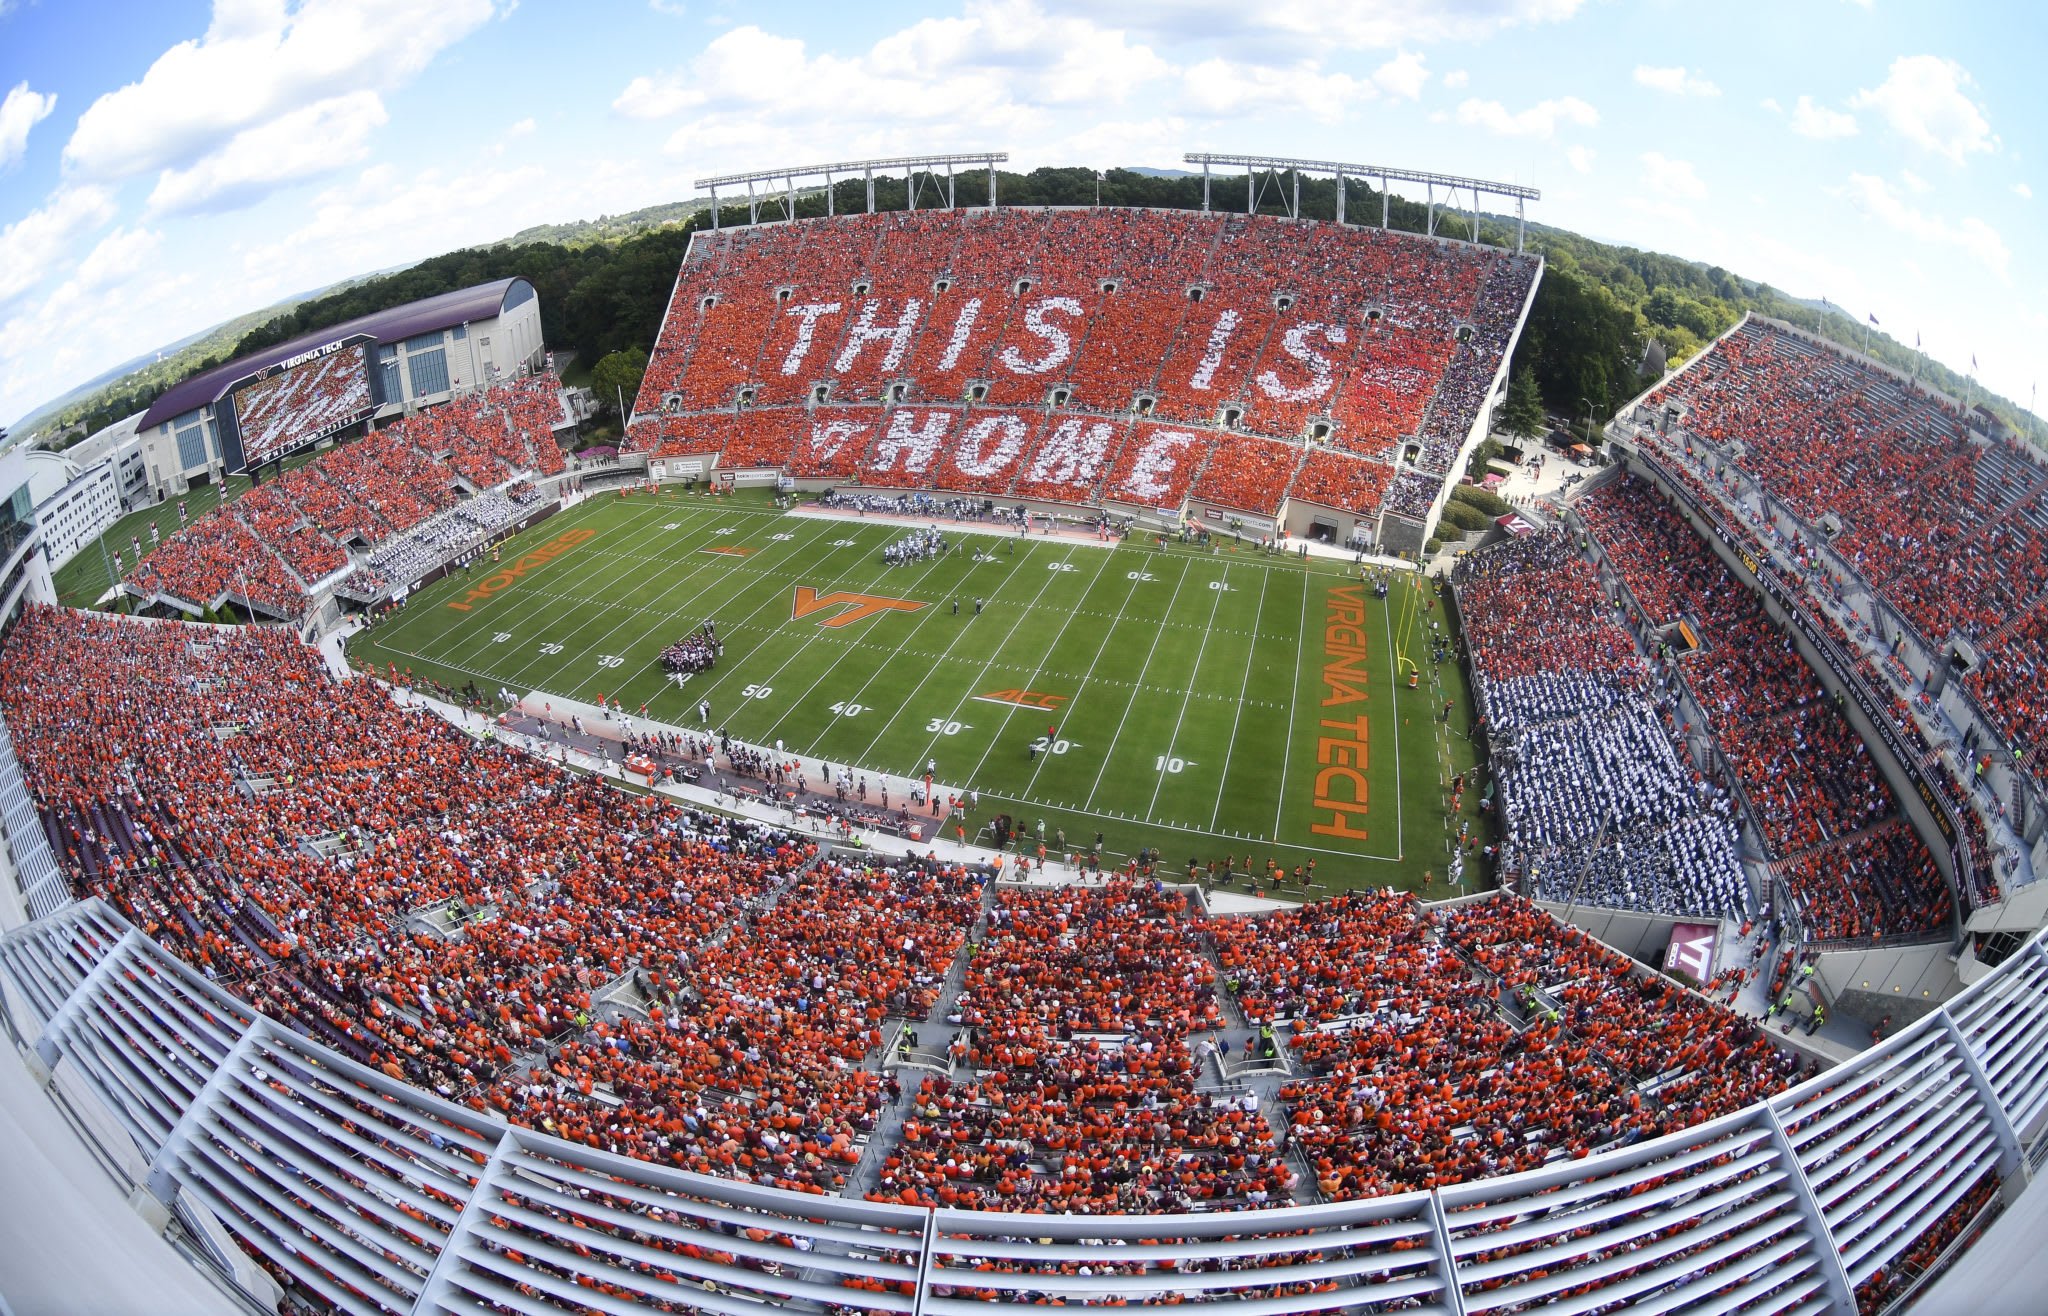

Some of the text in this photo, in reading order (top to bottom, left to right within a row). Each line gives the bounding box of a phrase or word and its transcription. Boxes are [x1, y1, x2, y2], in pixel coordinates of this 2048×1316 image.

[280, 340, 343, 371] VIRGINIA TECH
[781, 297, 1348, 403] THIS IS
[255, 365, 272, 381] VT
[865, 410, 1196, 501] HOME
[454, 541, 490, 566] HOKIES
[447, 528, 597, 611] HOKIES
[1047, 562, 1075, 572] 30
[1742, 554, 1758, 575] 15:00
[1127, 571, 1154, 582] 20
[790, 585, 934, 629] VT
[493, 632, 512, 643] 10
[538, 643, 564, 655] 20
[597, 656, 625, 668] 30
[741, 684, 773, 699] 50
[979, 688, 1069, 710] ACC
[828, 701, 863, 717] 40
[1311, 585, 1369, 841] VIRGINIA TECH
[1804, 626, 1816, 642] NEED
[1815, 639, 1822, 649] TO
[1821, 647, 1833, 665] COOL
[1862, 700, 1873, 715] GOT
[1872, 714, 1881, 728] ICE
[1880, 724, 1893, 745] COLD
[1892, 742, 1910, 770] DRINKS
[1909, 769, 1917, 780] AT
[925, 717, 962, 736] 30
[1034, 736, 1071, 755] 20
[1155, 755, 1185, 774] 10
[1680, 935, 1714, 982] VT
